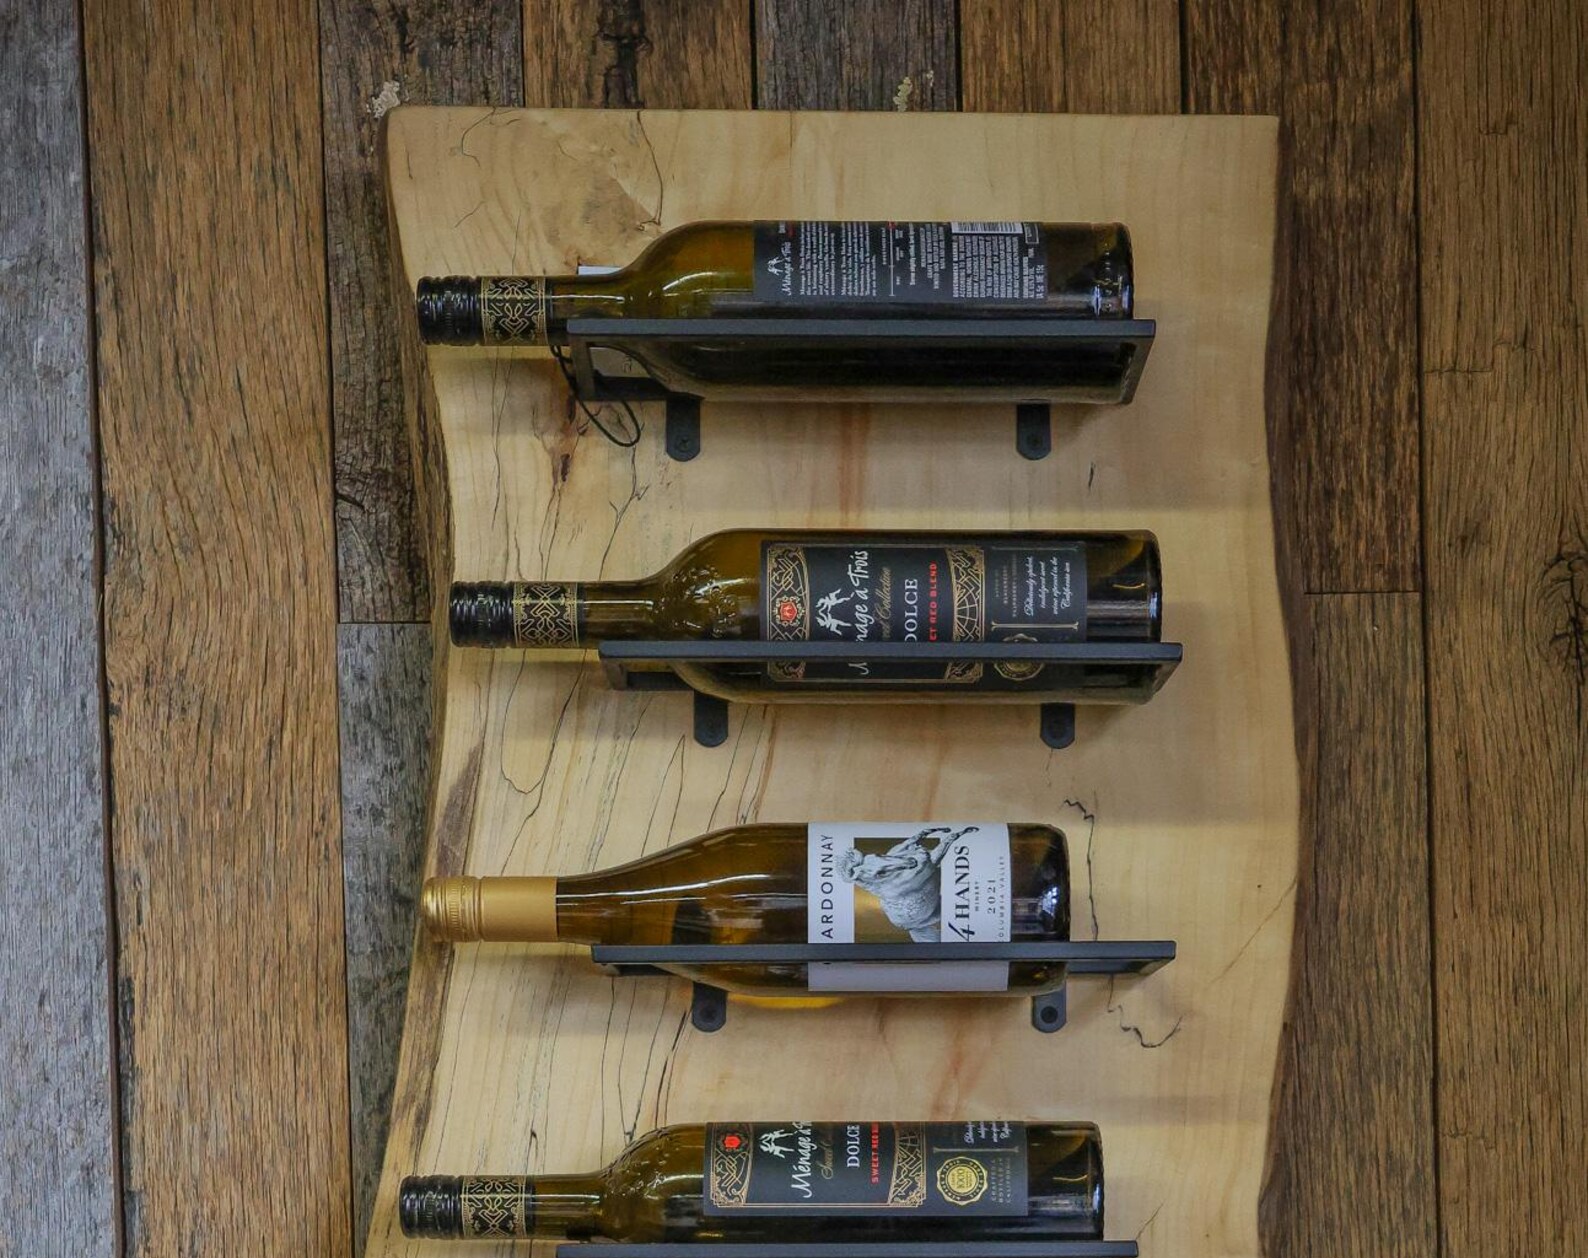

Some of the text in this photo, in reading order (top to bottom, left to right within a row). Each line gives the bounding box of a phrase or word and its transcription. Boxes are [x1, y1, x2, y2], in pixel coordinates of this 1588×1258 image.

[847, 550, 869, 586] Trois
[929, 561, 938, 596] BLEND
[850, 588, 865, 600] à
[929, 601, 938, 623] RED
[820, 834, 834, 939] ARDONNAY
[954, 845, 970, 918] HANDS
[987, 879, 996, 913] 2021
[846, 1124, 861, 1167] DOLCE
[790, 1136, 817, 1197] Ménage
[871, 1151, 879, 1182] SWEET
